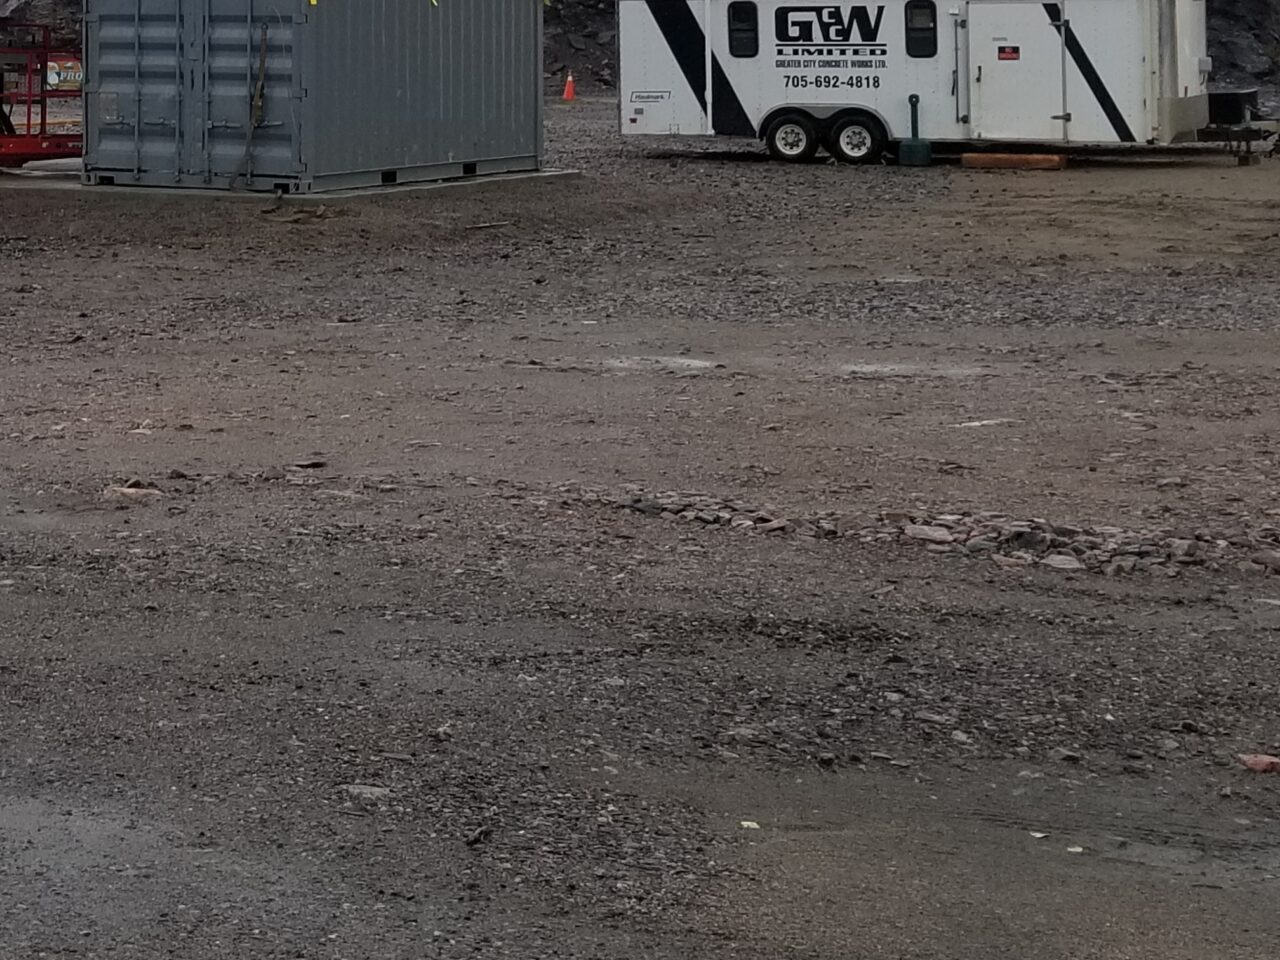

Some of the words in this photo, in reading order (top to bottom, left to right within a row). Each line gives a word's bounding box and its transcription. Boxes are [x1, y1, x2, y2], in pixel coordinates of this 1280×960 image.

[776, 48, 888, 56] LIMITED
[775, 59, 801, 68] GREATER
[803, 59, 816, 68] CITY
[818, 59, 848, 68] CONCRETE
[850, 59, 873, 68] WORKS
[783, 75, 881, 89] 705-692-4818
